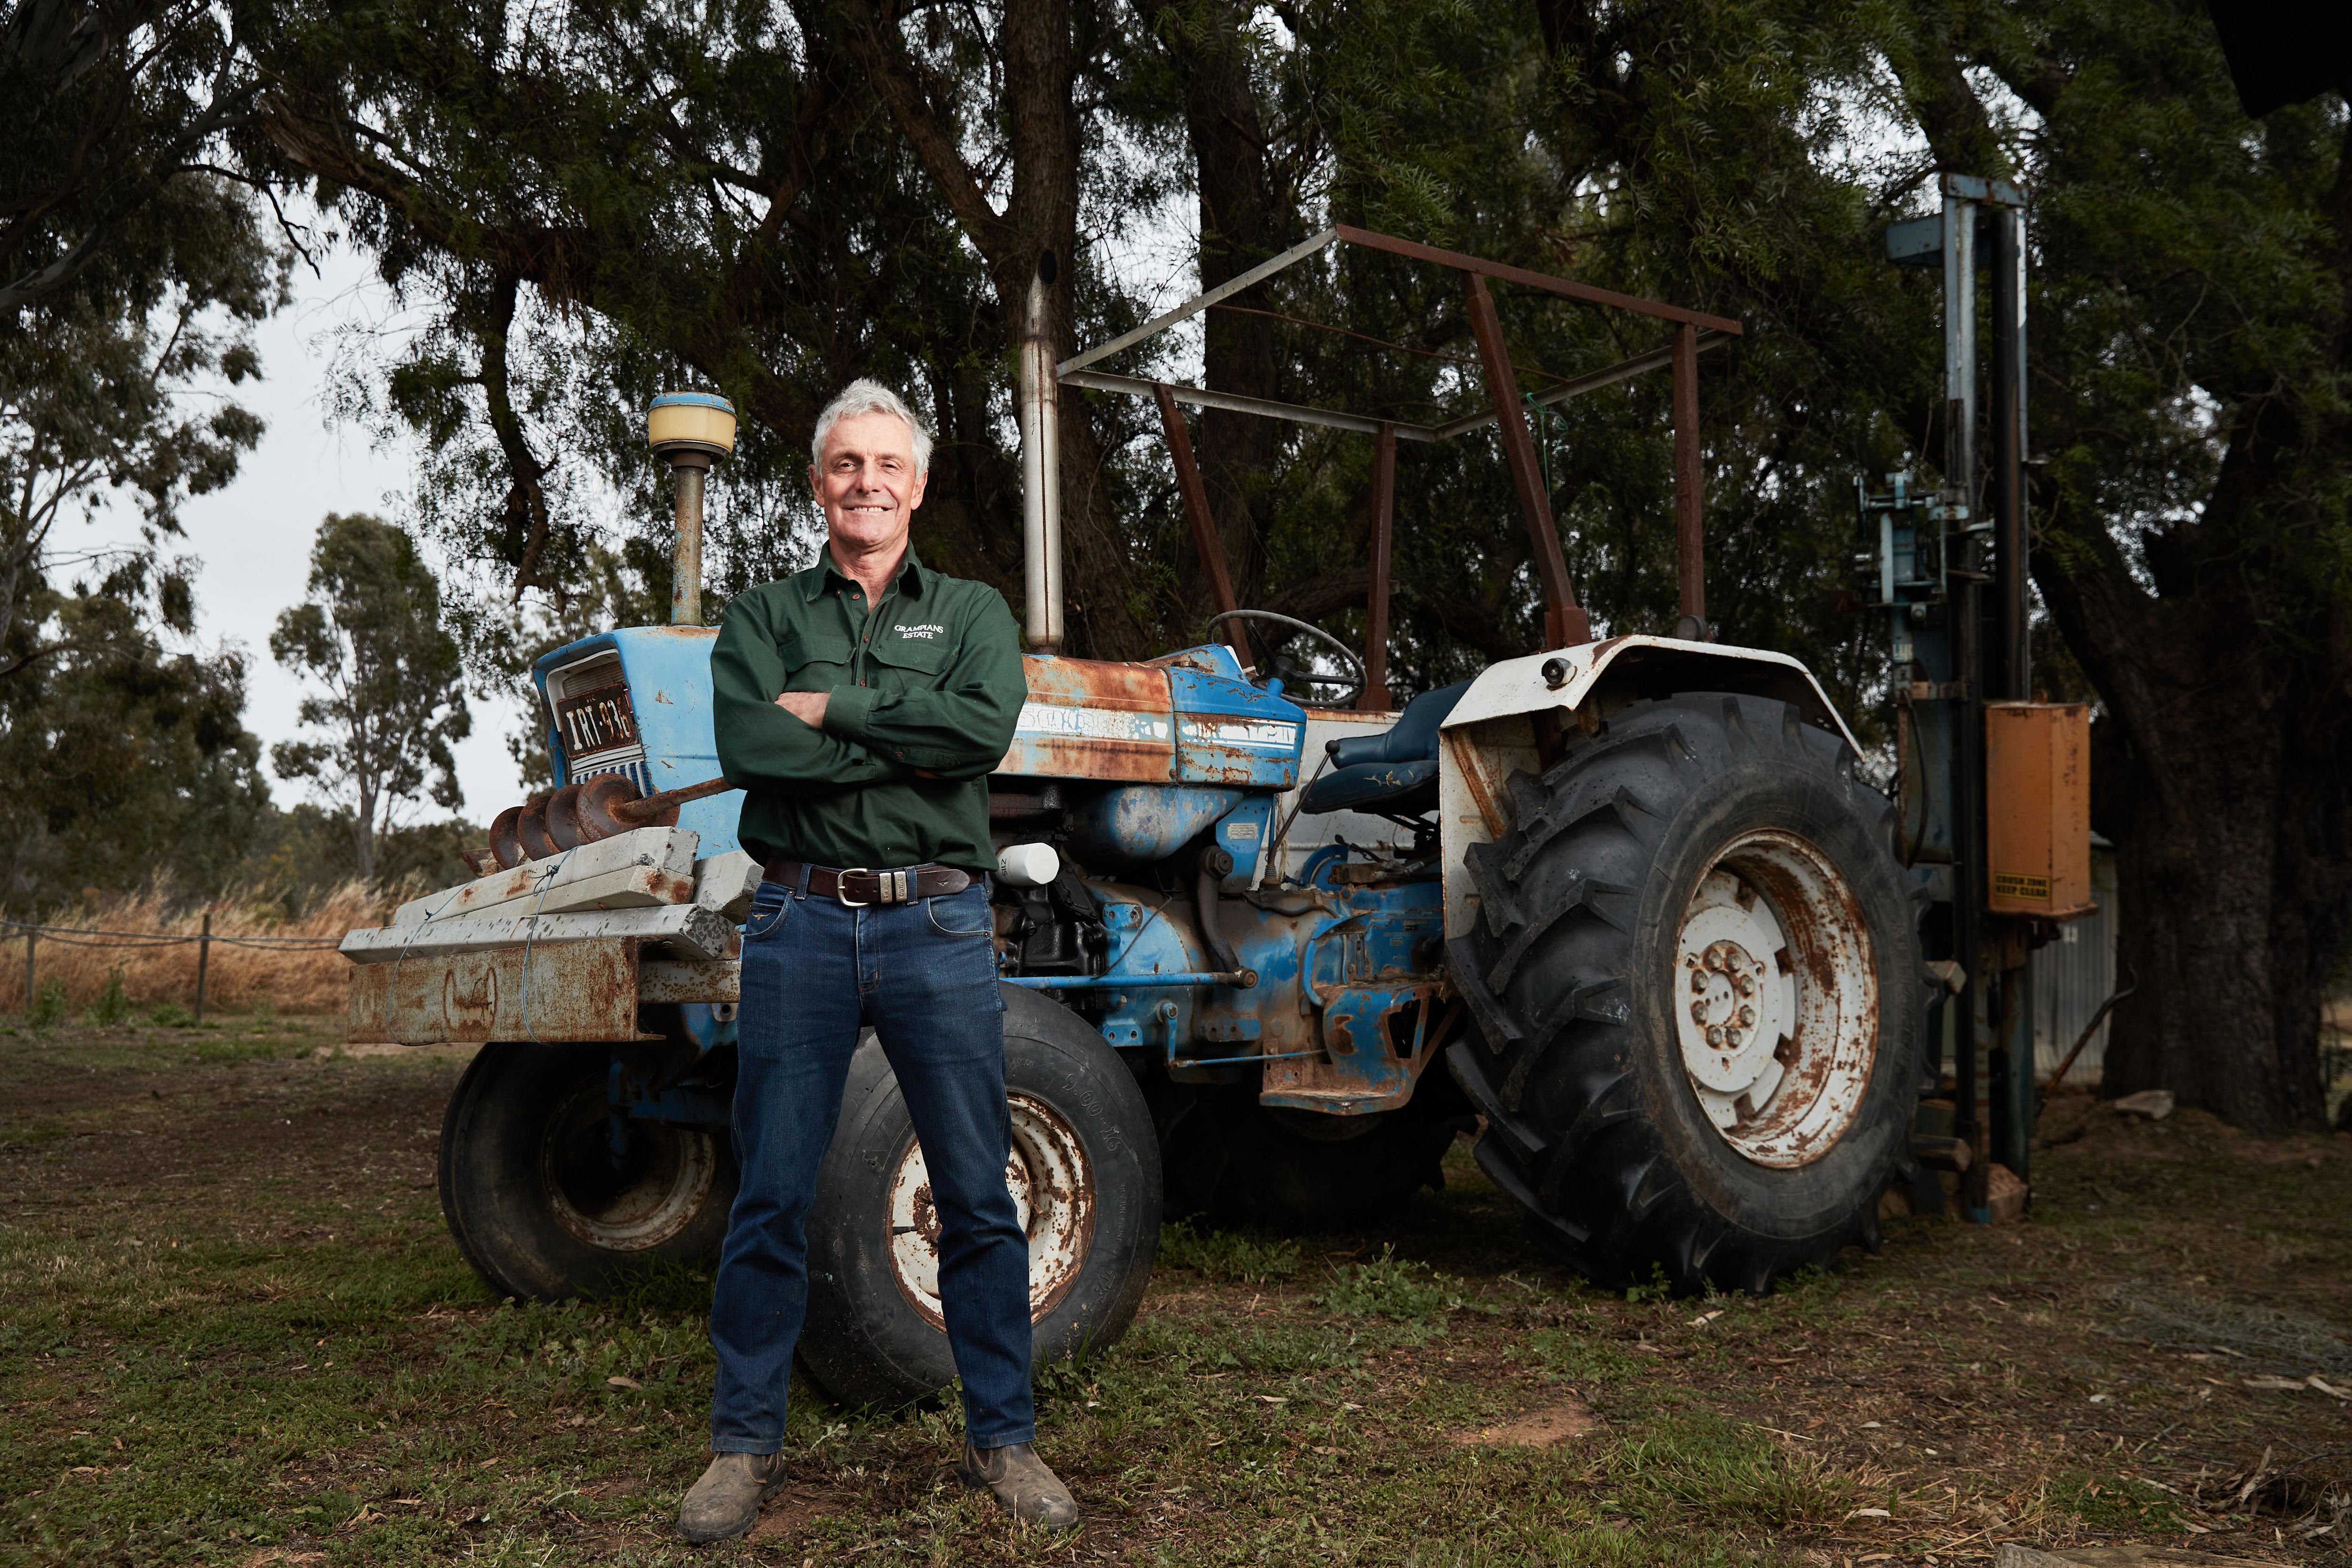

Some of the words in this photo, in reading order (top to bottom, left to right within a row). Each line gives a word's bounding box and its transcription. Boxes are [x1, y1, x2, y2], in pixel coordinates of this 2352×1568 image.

[894, 624, 944, 633] GRAMPIANS
[2027, 877, 2047, 887] ZONE
[1995, 884, 2017, 894] KEEP
[2019, 887, 2046, 897] CLEAR
[1062, 1073, 1121, 1152] 9.00-16
